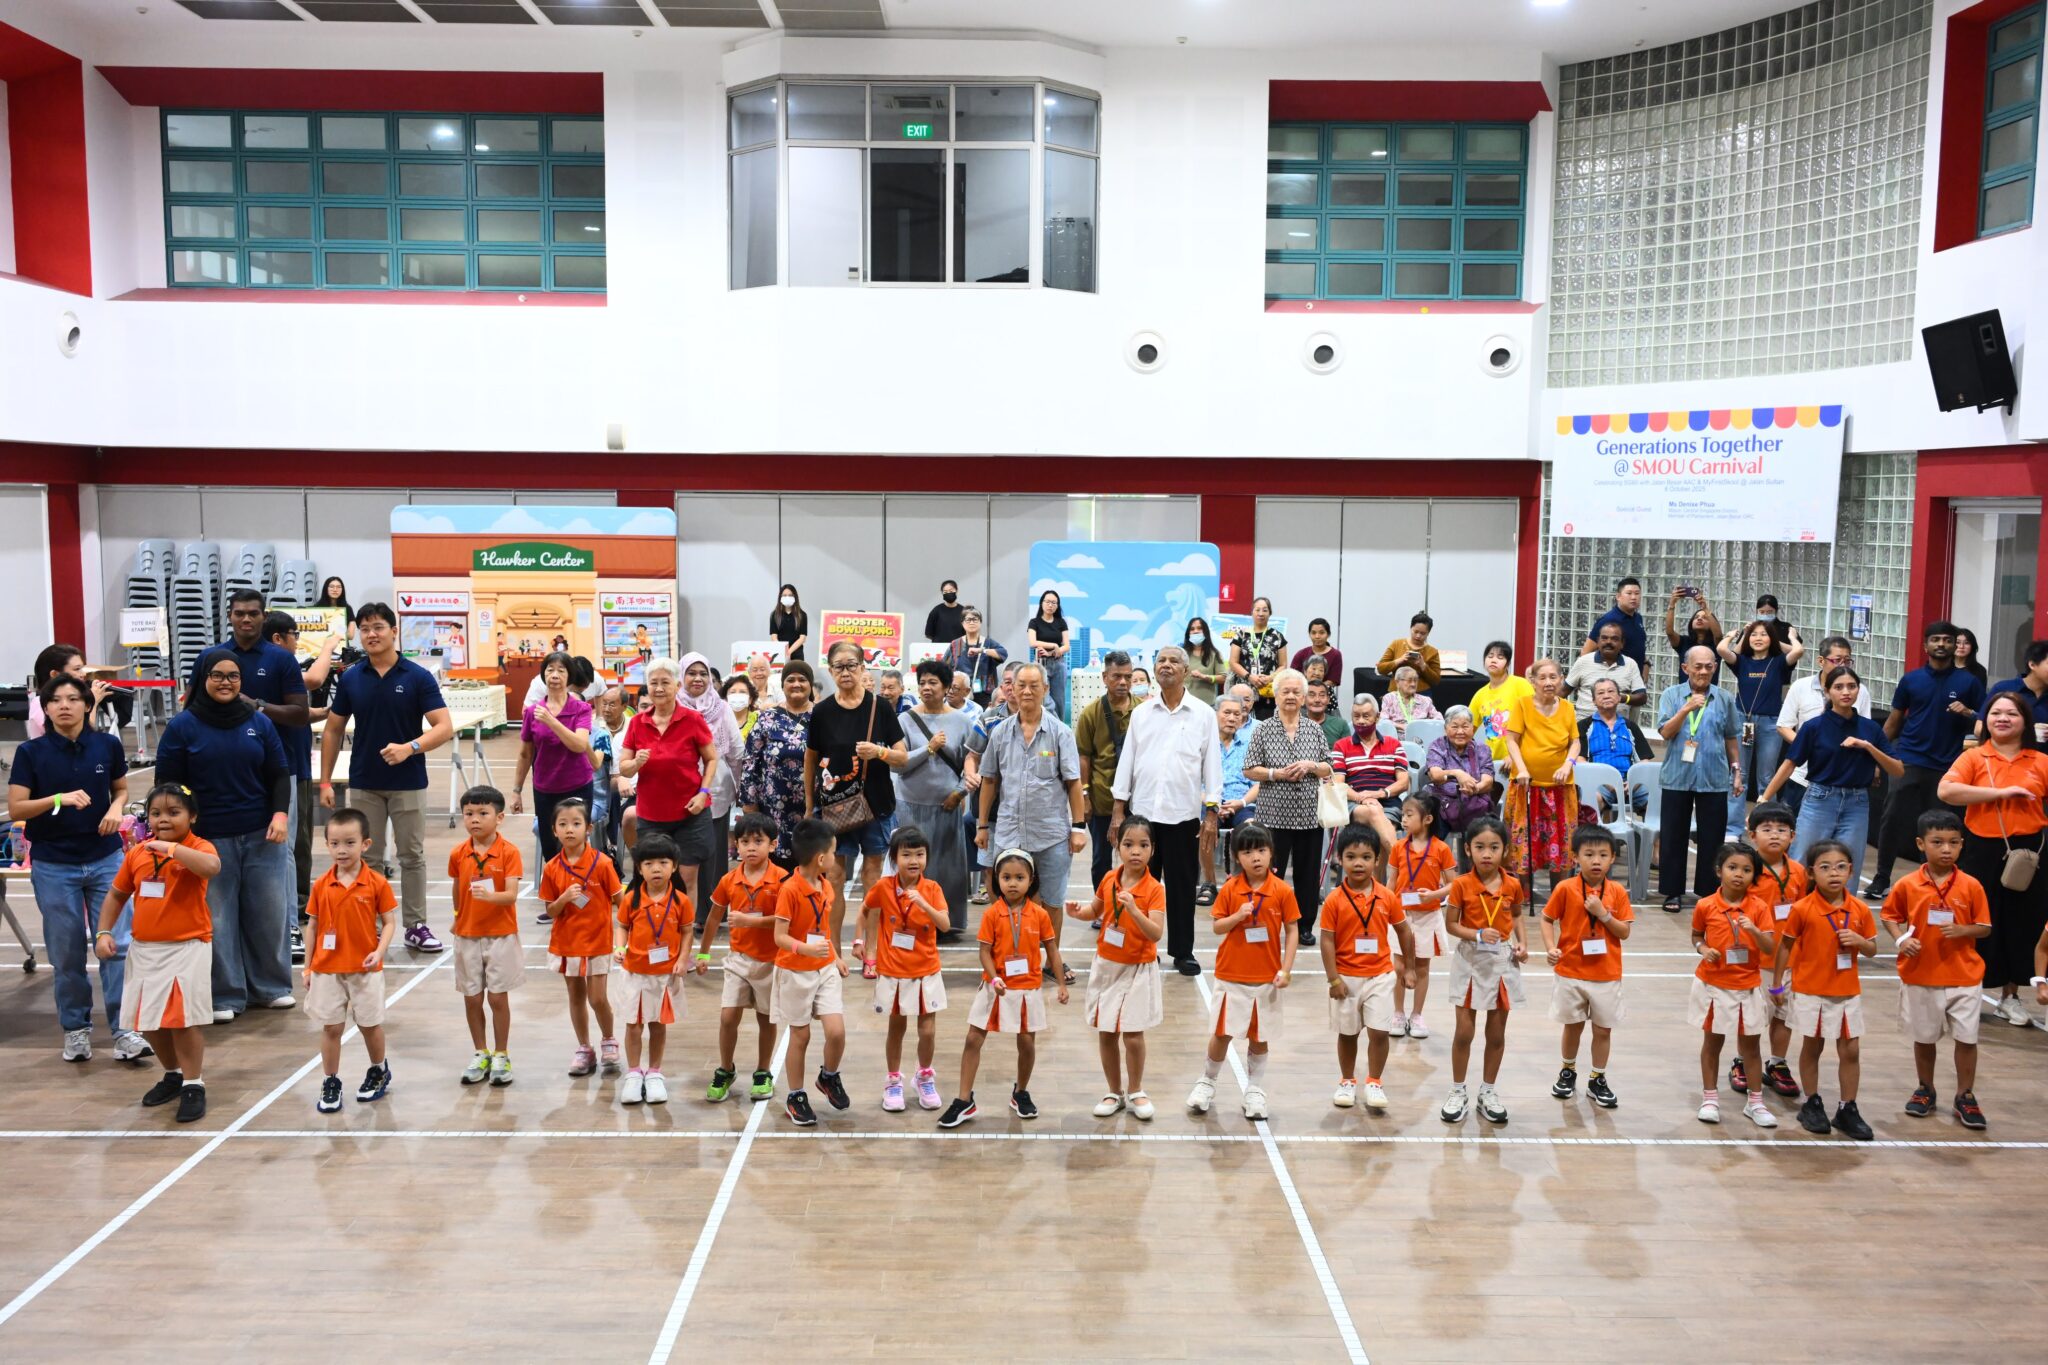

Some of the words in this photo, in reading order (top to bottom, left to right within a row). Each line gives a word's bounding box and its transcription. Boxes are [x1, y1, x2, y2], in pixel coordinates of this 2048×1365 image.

[907, 125, 928, 137] EXIT
[1596, 437, 1697, 455] Generations
[1700, 433, 1784, 458] Together
[1614, 459, 1629, 477] @
[1632, 458, 1686, 475] SMOU
[1689, 455, 1763, 475] Carnival
[480, 550, 536, 566] Hawker
[540, 551, 585, 567] Center
[836, 617, 886, 626] ROOSTER
[828, 625, 861, 634] BOWL
[862, 626, 894, 636] PONG
